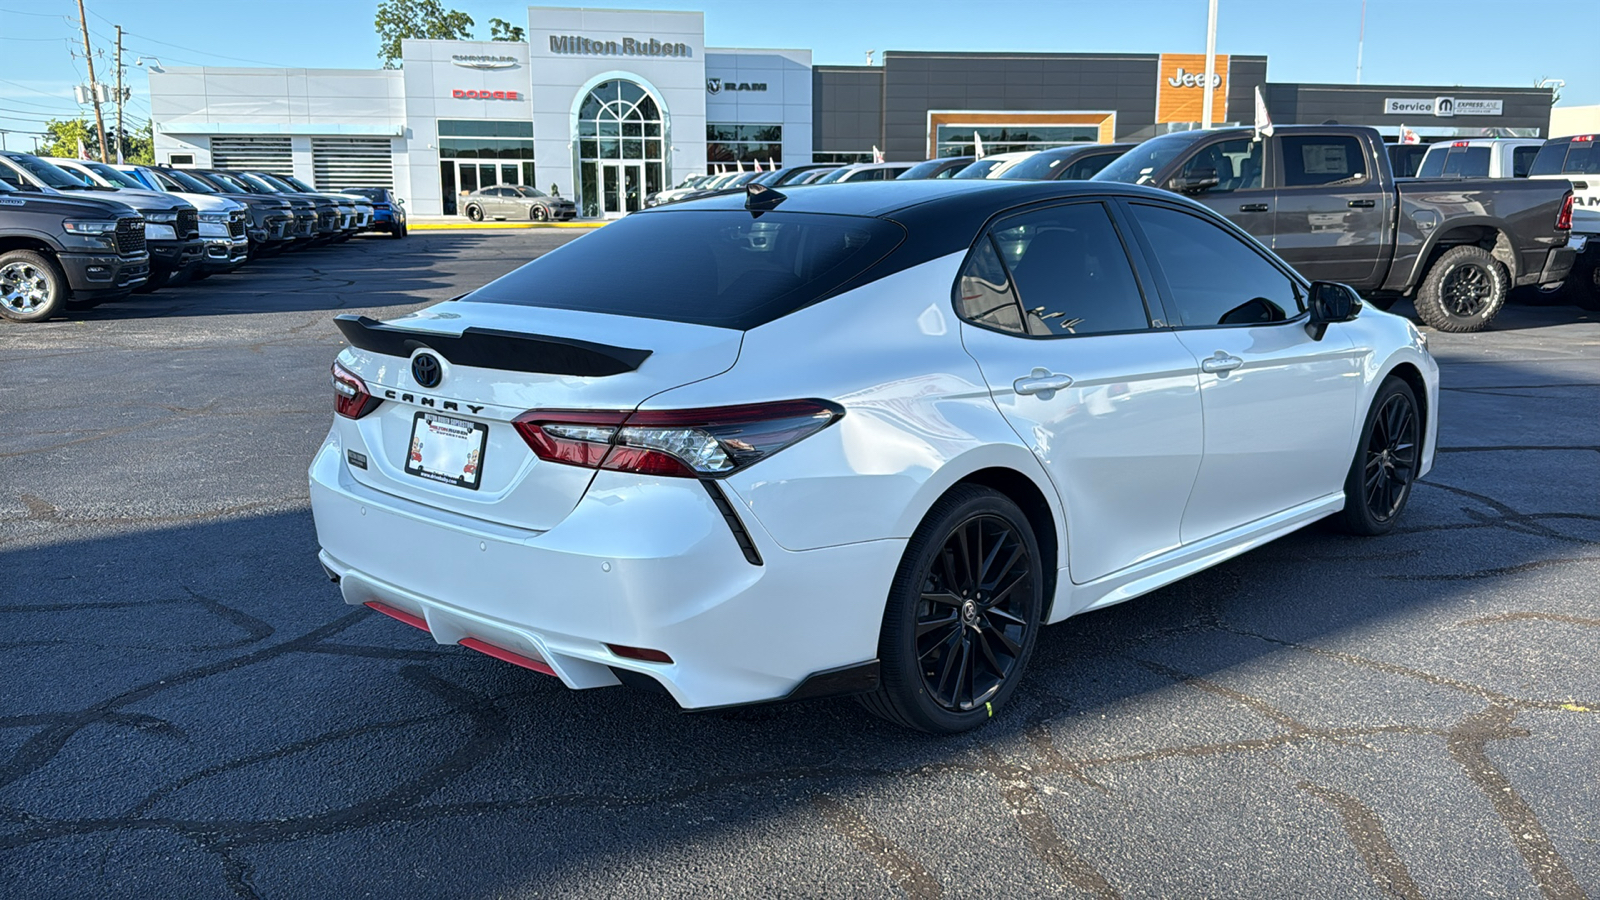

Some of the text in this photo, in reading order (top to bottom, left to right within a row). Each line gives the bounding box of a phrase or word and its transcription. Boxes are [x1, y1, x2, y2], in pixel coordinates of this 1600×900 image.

[549, 35, 687, 56] Milton Ruben
[1168, 67, 1221, 88] Jeep
[452, 89, 518, 100] DODGE
[724, 82, 767, 91] RAM
[1391, 101, 1432, 111] Service
[385, 390, 484, 414] CAMRY
